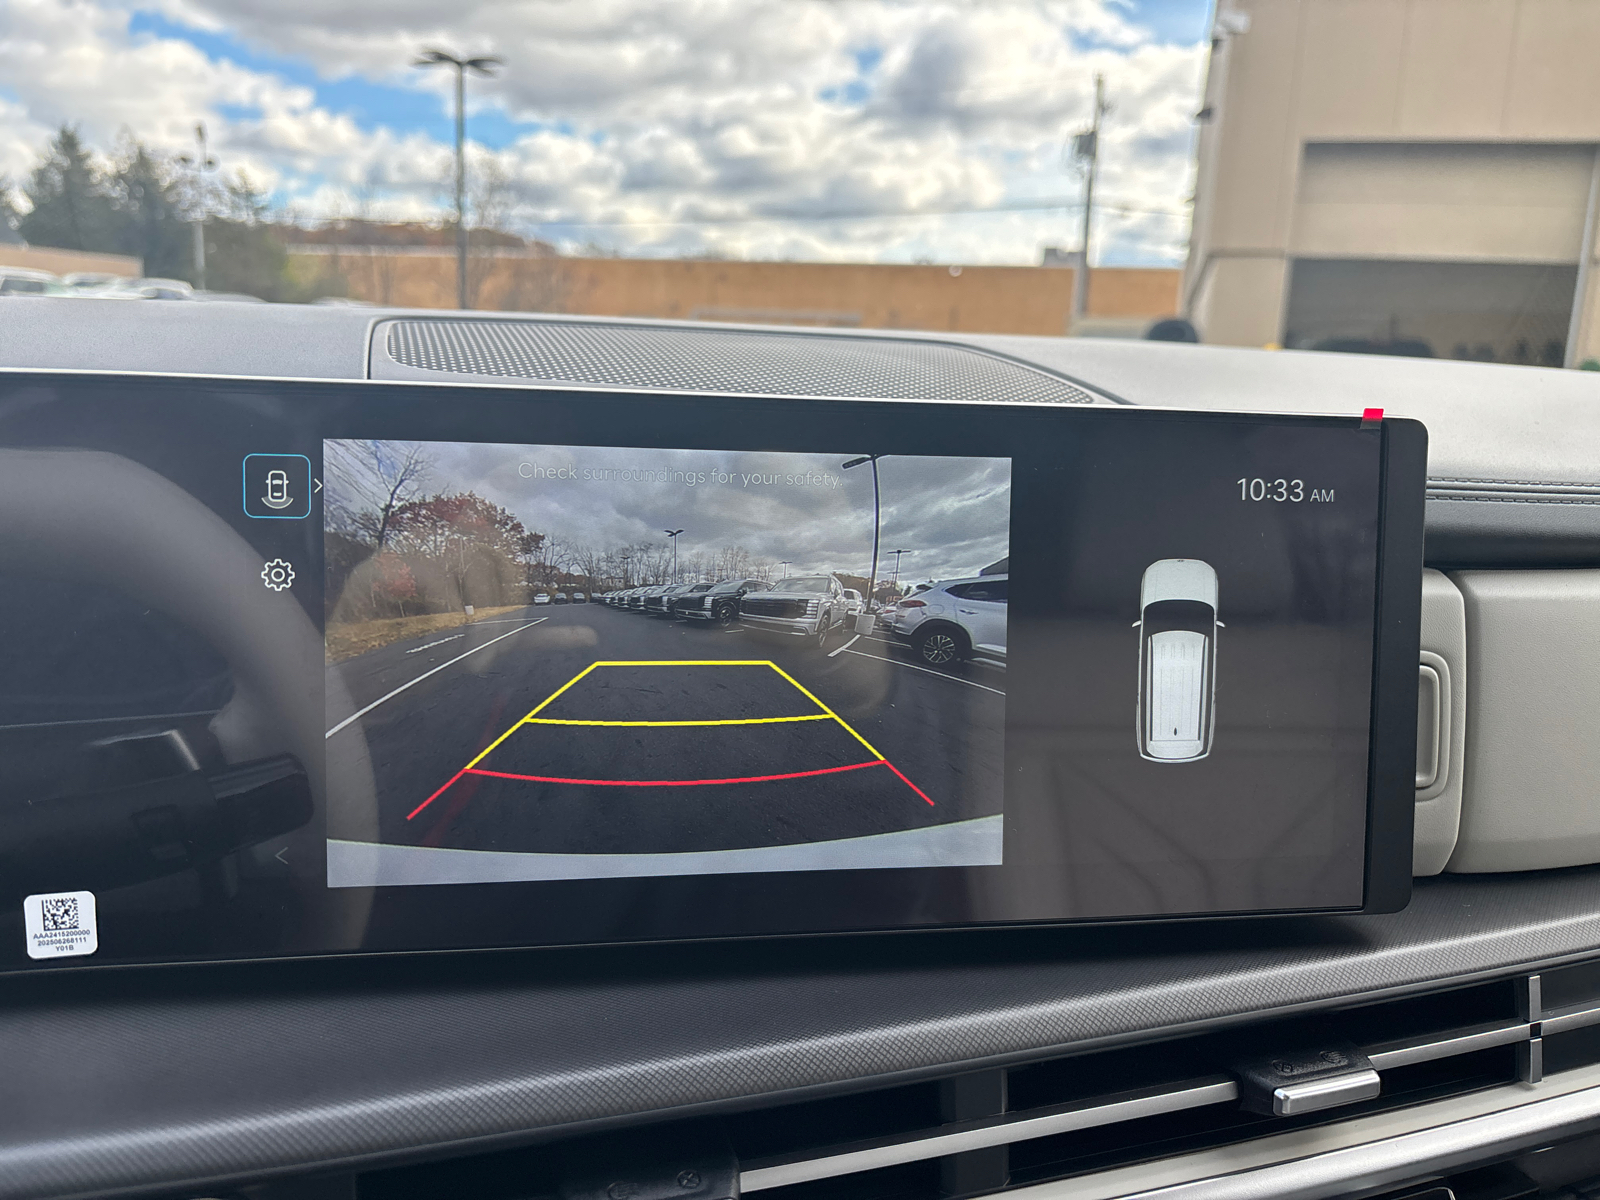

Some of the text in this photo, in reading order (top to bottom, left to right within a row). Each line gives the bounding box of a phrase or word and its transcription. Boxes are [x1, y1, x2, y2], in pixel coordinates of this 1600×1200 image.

[517, 462, 844, 490] Check surroundings for your safety.
[1237, 478, 1335, 503] 10:33 AM
[33, 929, 90, 939] AAA2415200000
[38, 936, 87, 946] 202506268111
